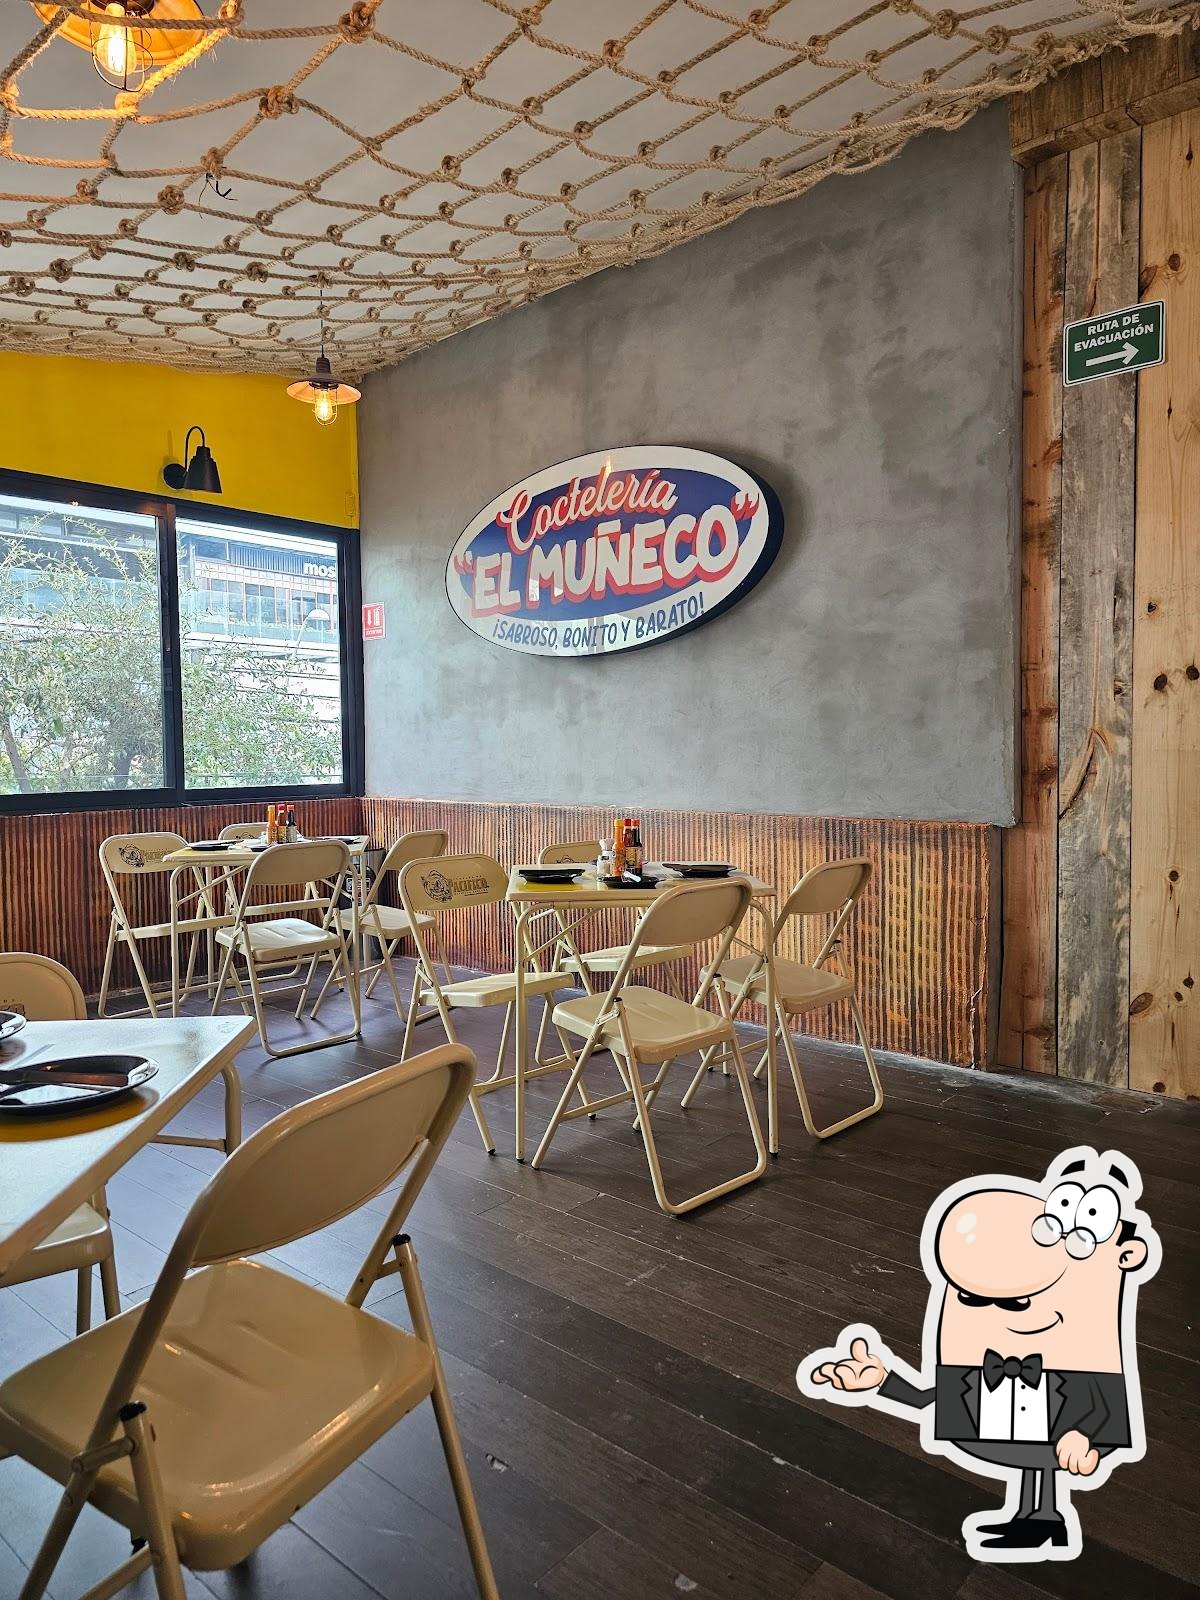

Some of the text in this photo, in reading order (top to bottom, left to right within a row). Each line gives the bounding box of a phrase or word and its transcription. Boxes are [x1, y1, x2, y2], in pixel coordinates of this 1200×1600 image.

[1074, 323, 1154, 352] EVACUACIÓN
[1087, 313, 1140, 336] RUTA DE
[496, 465, 679, 553] Coctelería
[303, 561, 336, 580] mos
[492, 591, 705, 650] ¡SABROSO, BONITO Y BARATO!
